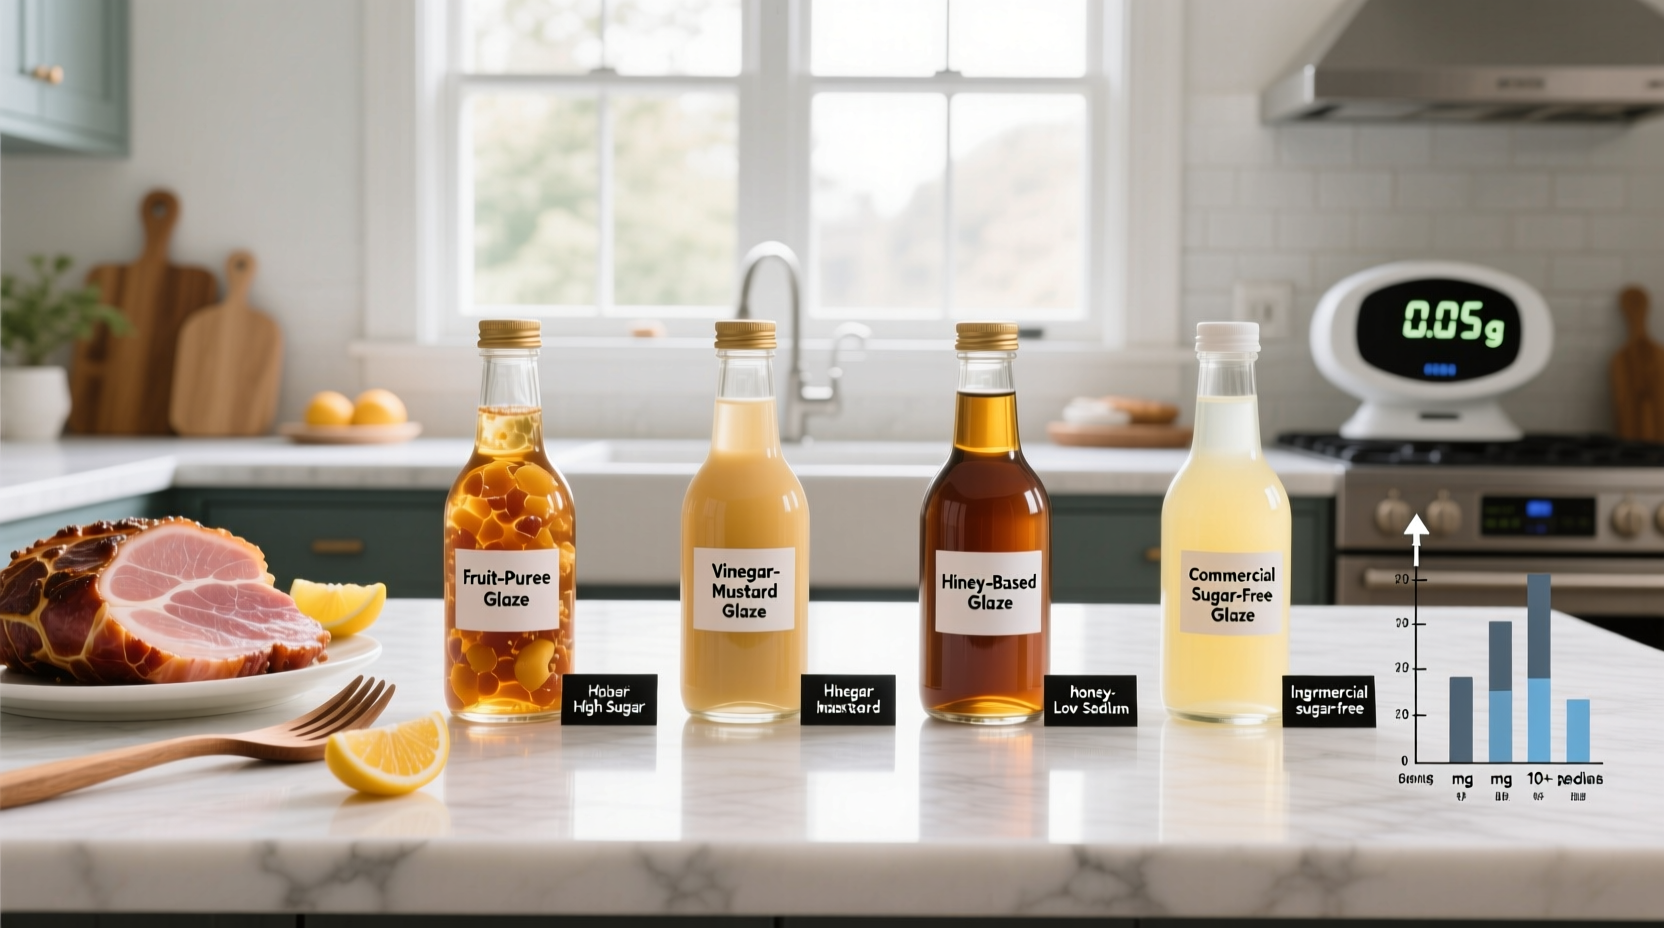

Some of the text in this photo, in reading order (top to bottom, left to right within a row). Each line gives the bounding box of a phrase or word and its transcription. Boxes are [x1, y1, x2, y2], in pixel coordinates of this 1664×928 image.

[1402, 300, 1505, 348] 0.05g
[463, 569, 551, 586] Fruit-Puree
[712, 563, 781, 582] Vinegar-
[1189, 567, 1275, 583] Commercial
[483, 590, 530, 608] Glaze
[712, 583, 778, 599] Mustard
[1191, 586, 1273, 605] Sugar-Free
[722, 603, 767, 619] Glaze
[967, 594, 1013, 611] Glaze
[1211, 607, 1256, 623] Glaze
[605, 700, 646, 717] Sugar
